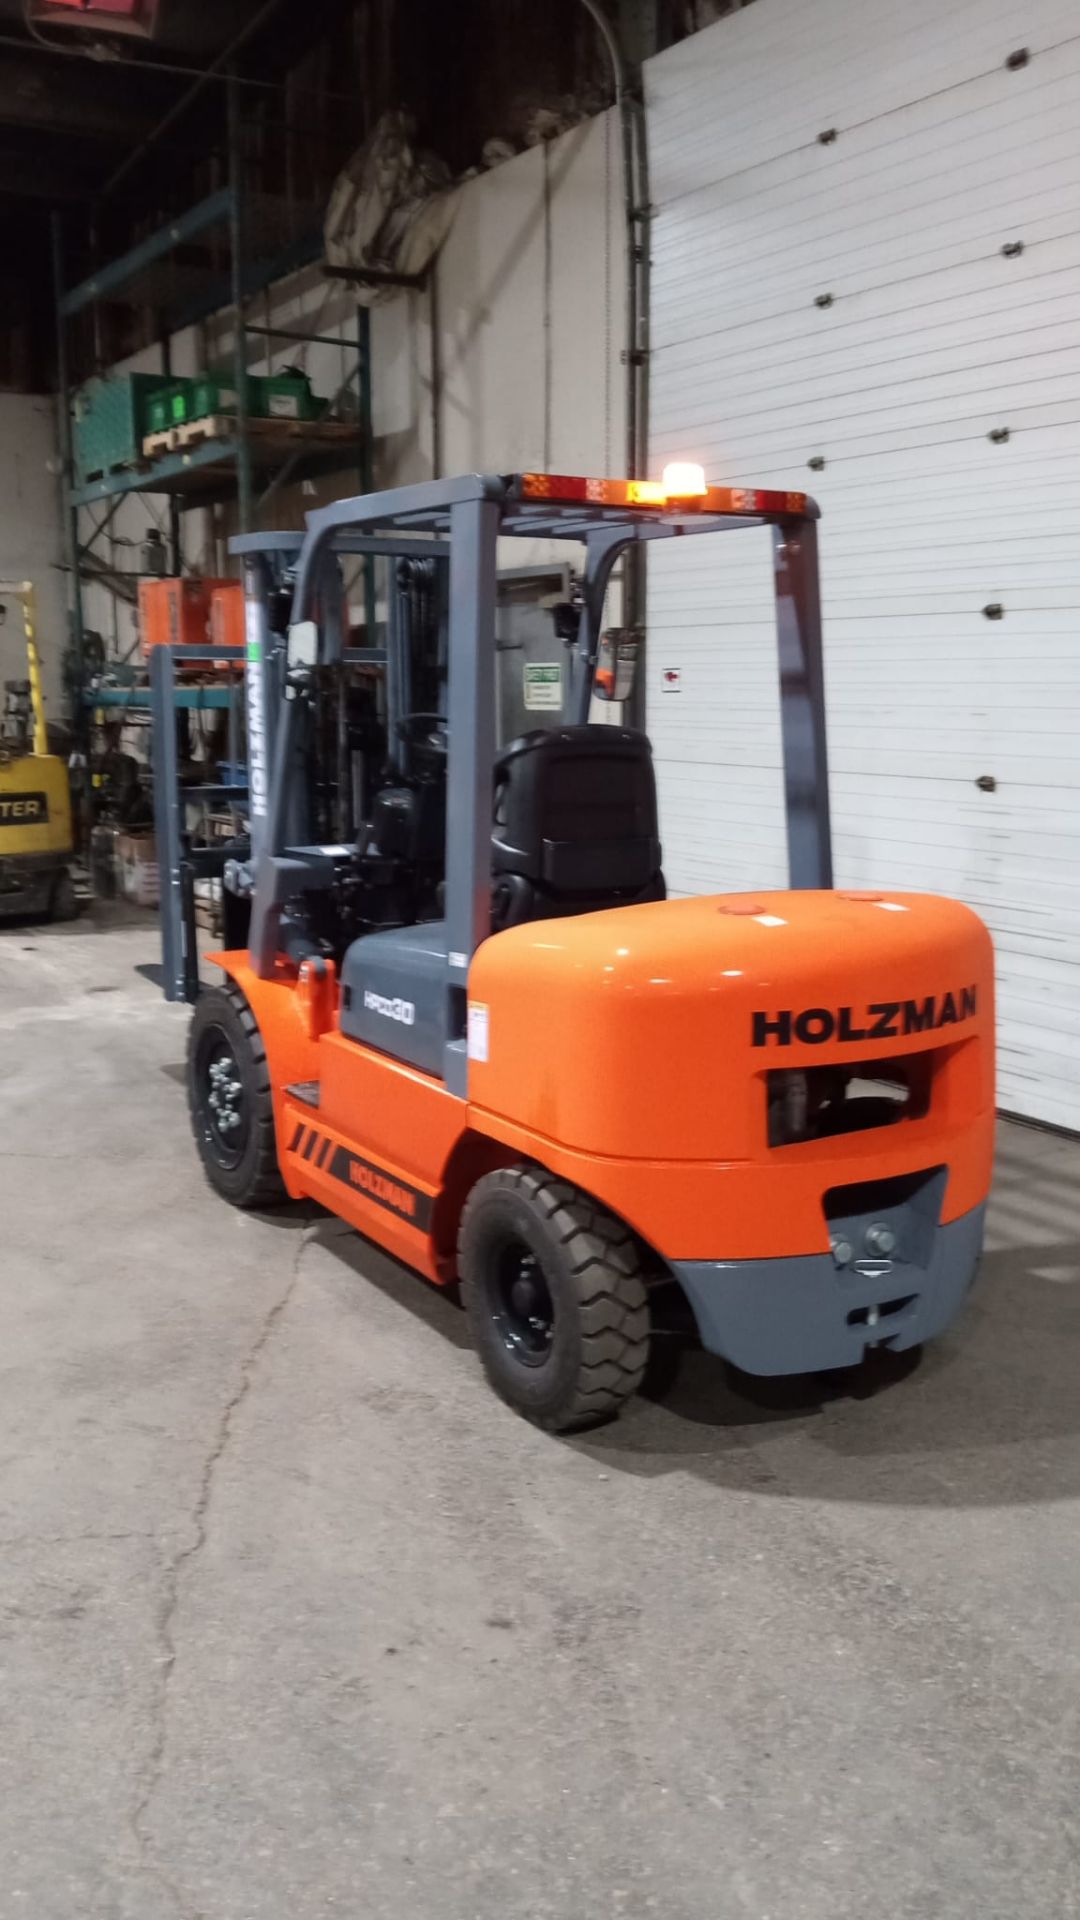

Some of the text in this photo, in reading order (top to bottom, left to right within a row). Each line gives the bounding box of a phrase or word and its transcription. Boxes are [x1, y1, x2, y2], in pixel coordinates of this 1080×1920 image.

[248, 663, 269, 817] HOLZMAN
[752, 984, 977, 1047] HOLZMAN
[349, 1160, 416, 1217] HOLZMAN
